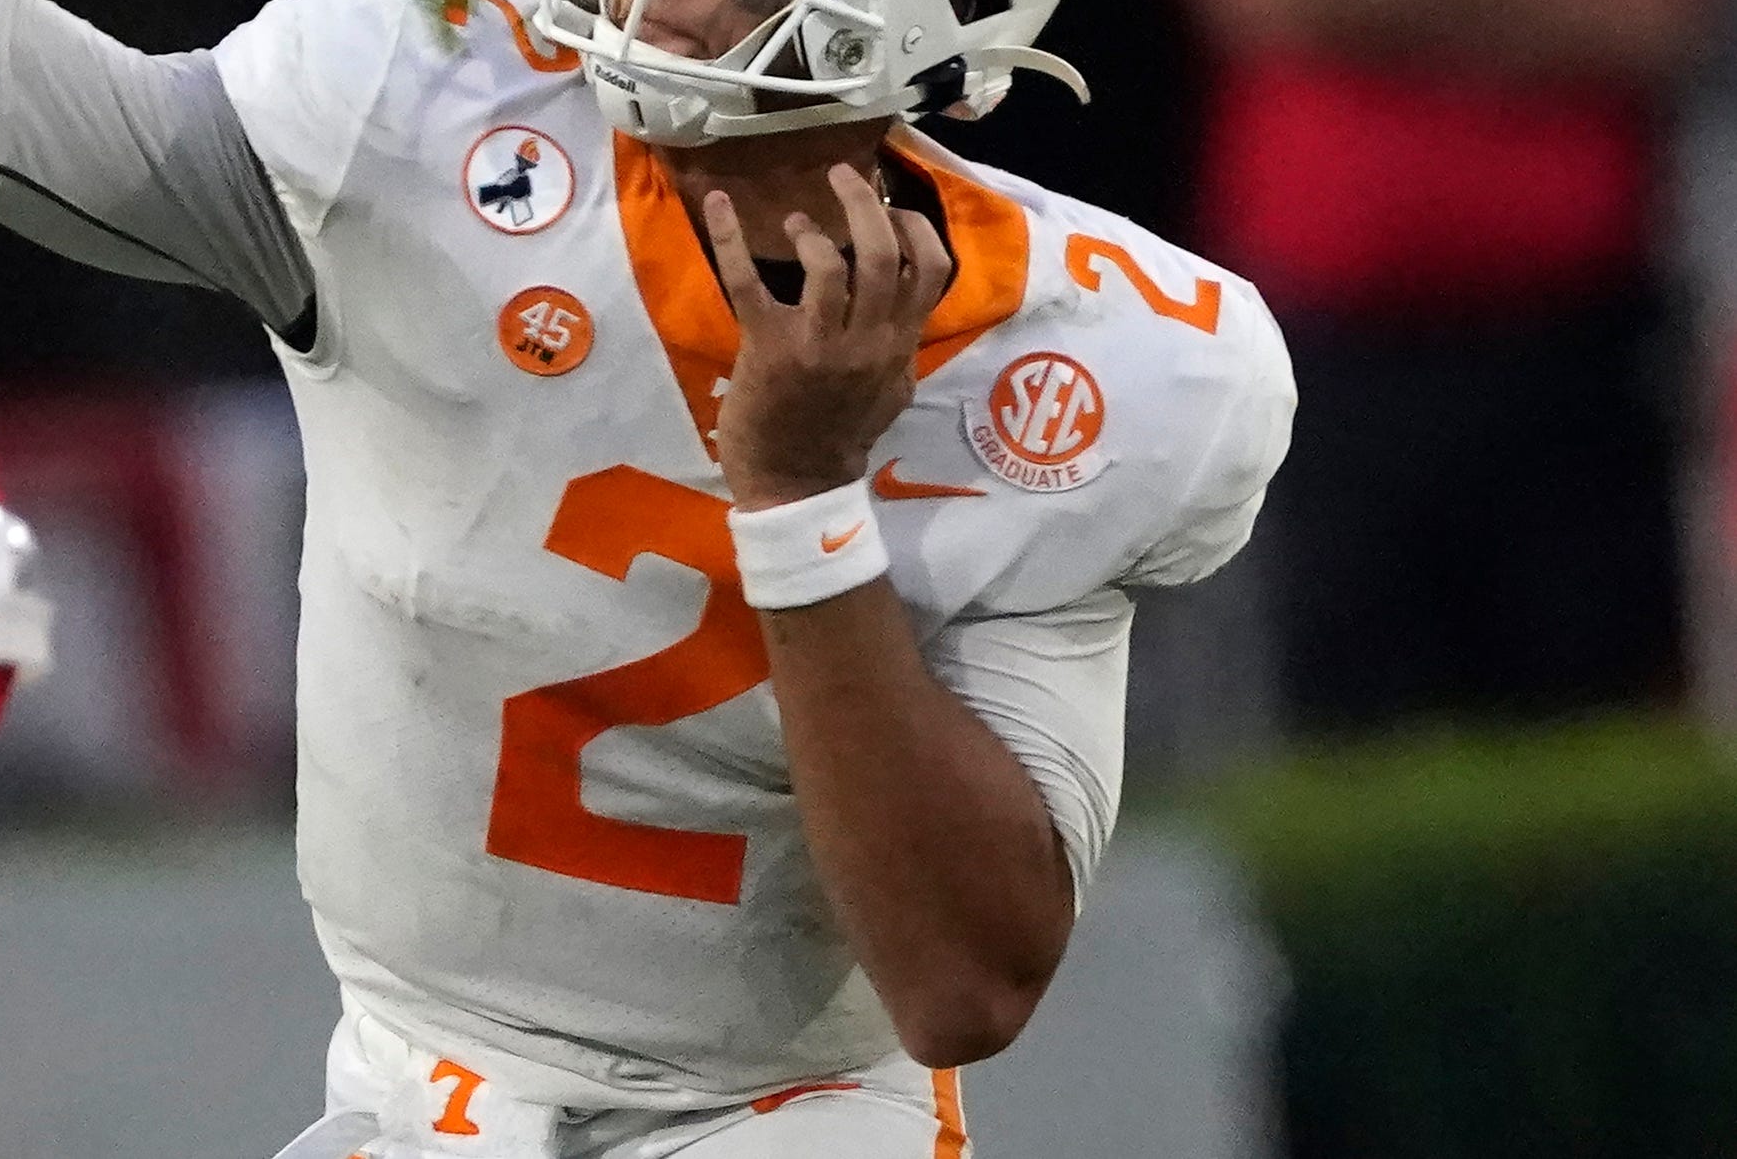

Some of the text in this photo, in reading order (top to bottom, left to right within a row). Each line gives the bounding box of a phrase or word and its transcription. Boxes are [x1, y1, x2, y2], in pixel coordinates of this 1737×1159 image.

[518, 301, 581, 351] 45
[1065, 233, 1221, 335] 2
[1000, 359, 1095, 456] SEC
[972, 425, 1083, 488] GRADUATE
[485, 463, 773, 906] 2
